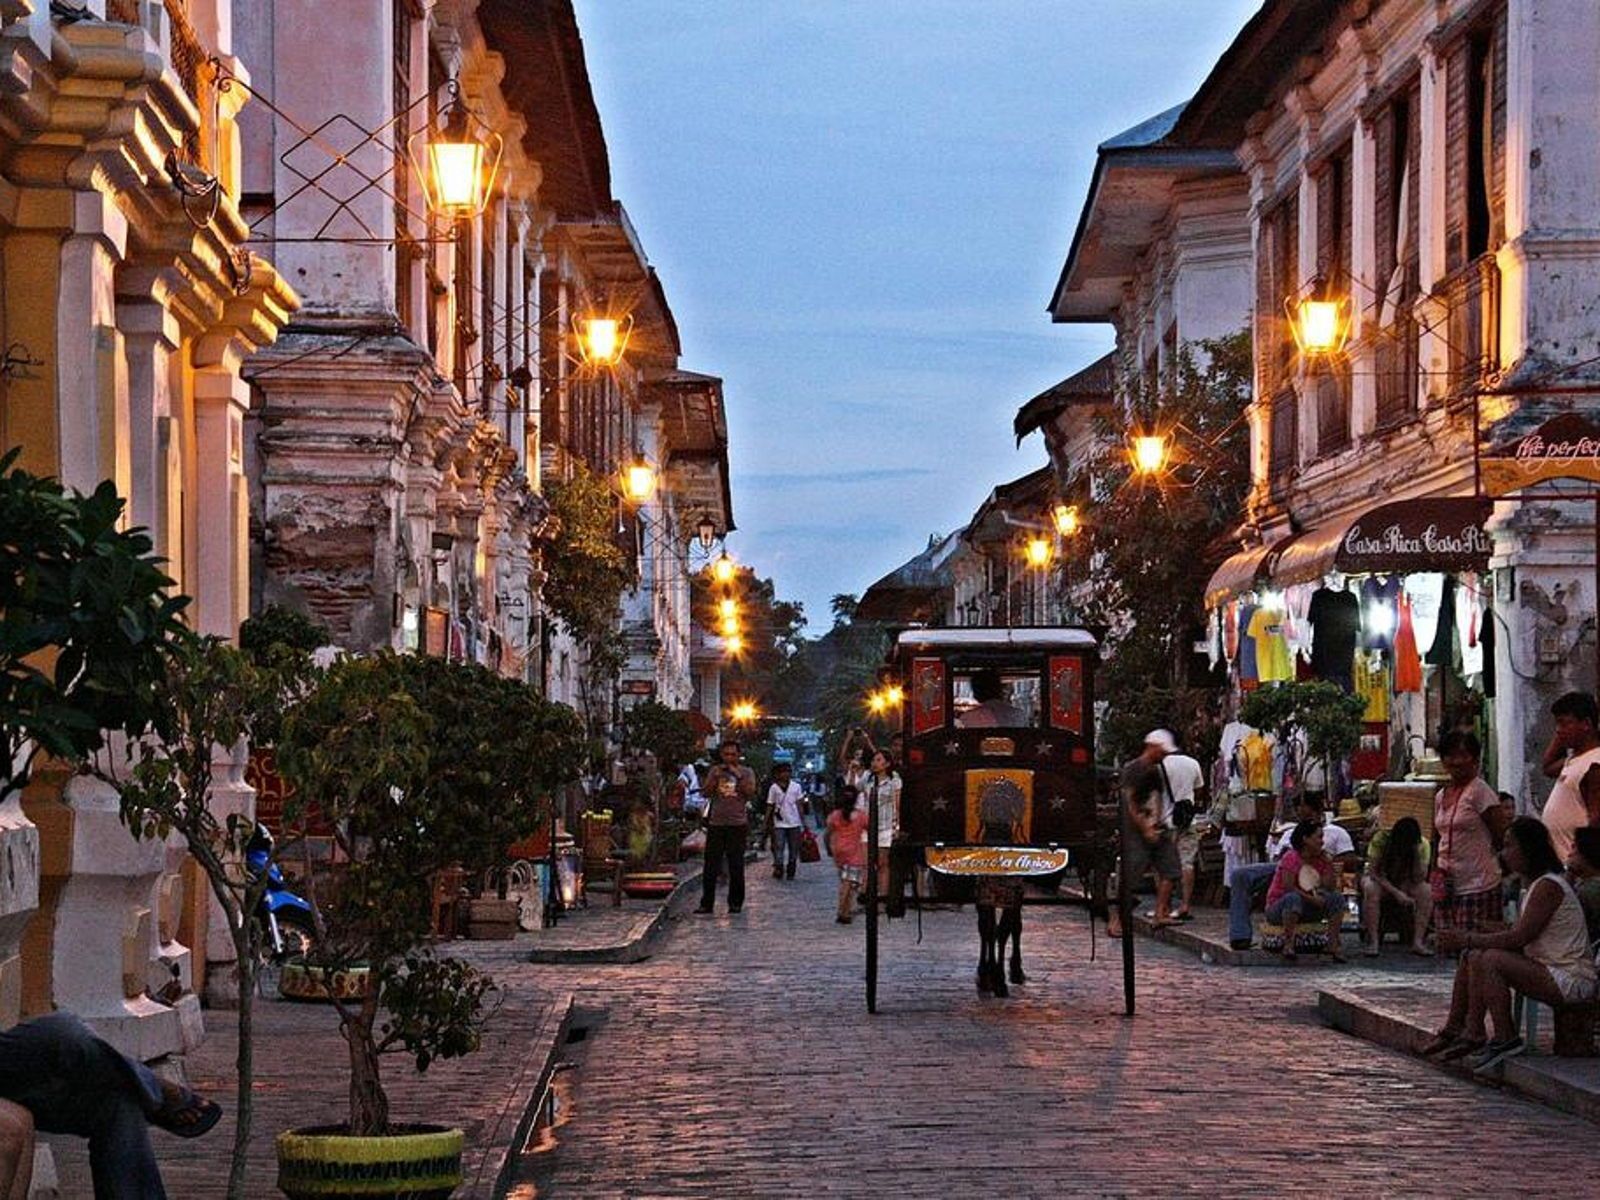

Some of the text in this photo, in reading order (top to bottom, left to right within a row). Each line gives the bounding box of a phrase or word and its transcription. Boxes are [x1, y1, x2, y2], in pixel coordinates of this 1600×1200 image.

[1345, 524, 1493, 554] Casa Rica Casa Ri
